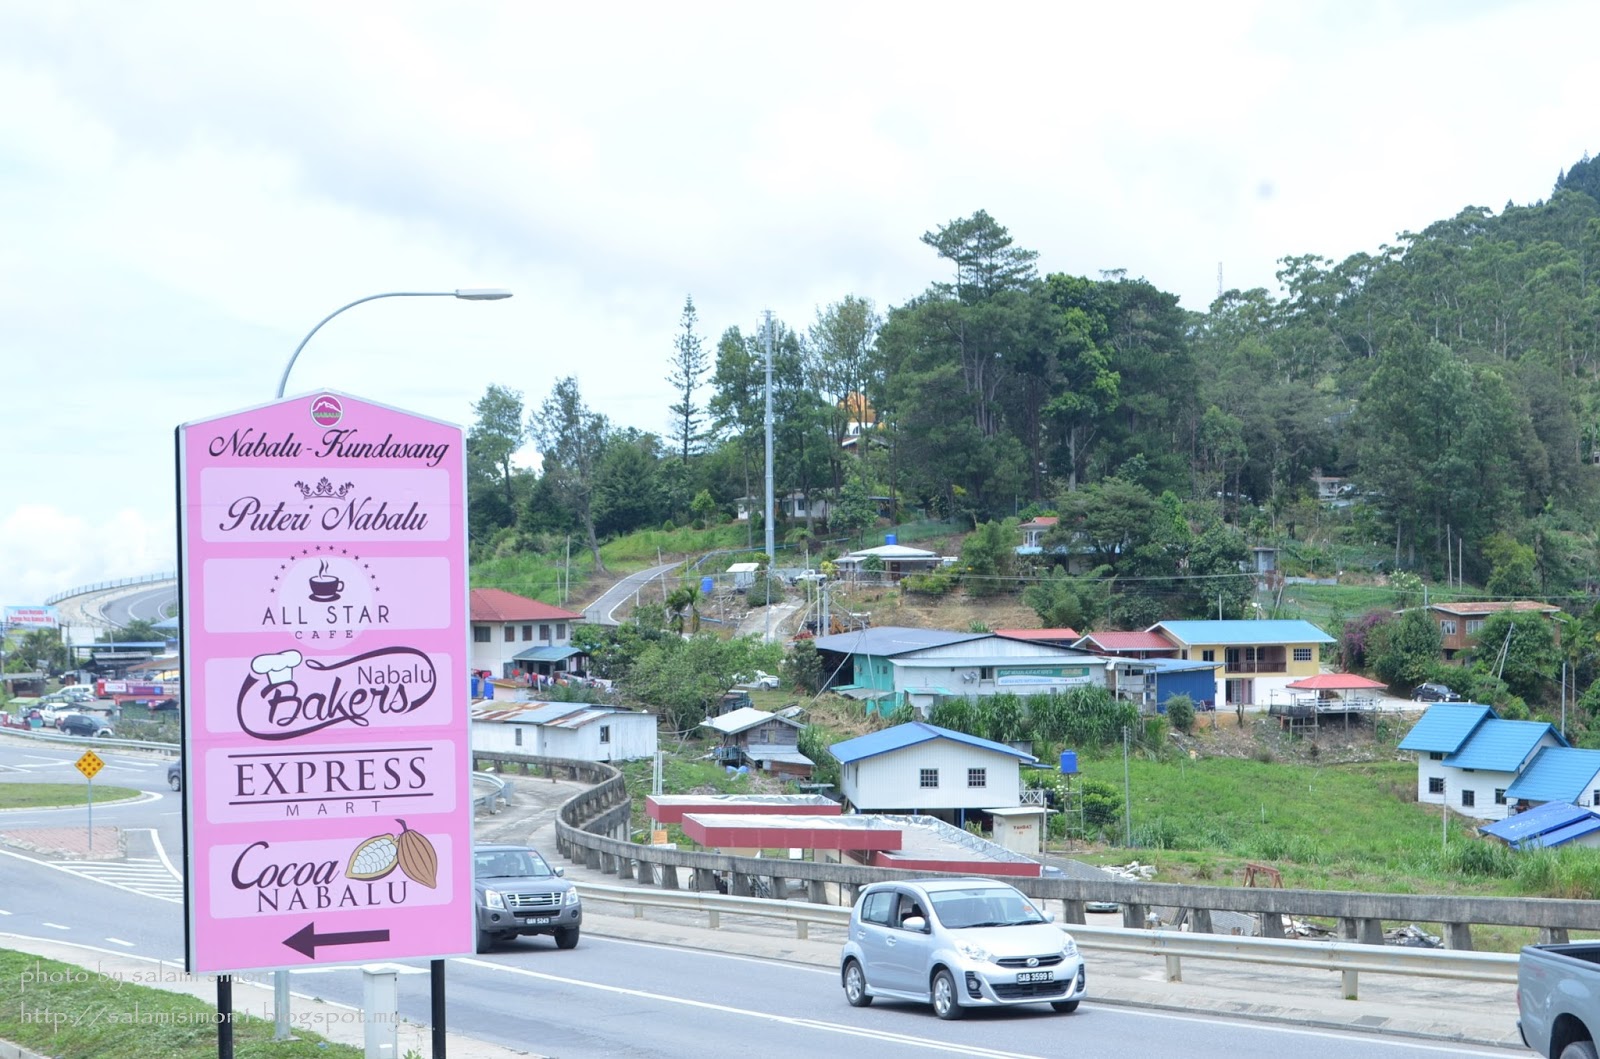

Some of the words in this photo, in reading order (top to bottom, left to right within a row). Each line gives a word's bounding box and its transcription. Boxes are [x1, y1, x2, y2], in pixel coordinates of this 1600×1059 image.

[219, 496, 312, 531] Puteri
[321, 497, 428, 531] Nabalu
[262, 606, 308, 625] ALL
[326, 605, 389, 624] STAR
[295, 630, 353, 640] CAFE
[357, 664, 433, 685] Nabalu
[261, 676, 408, 726] Bakers
[234, 757, 426, 796] EXPRESS
[286, 800, 381, 816] MART
[231, 841, 339, 890] Cocoa
[257, 880, 407, 913] NABALU
[1031, 973, 1047, 981] 3599
